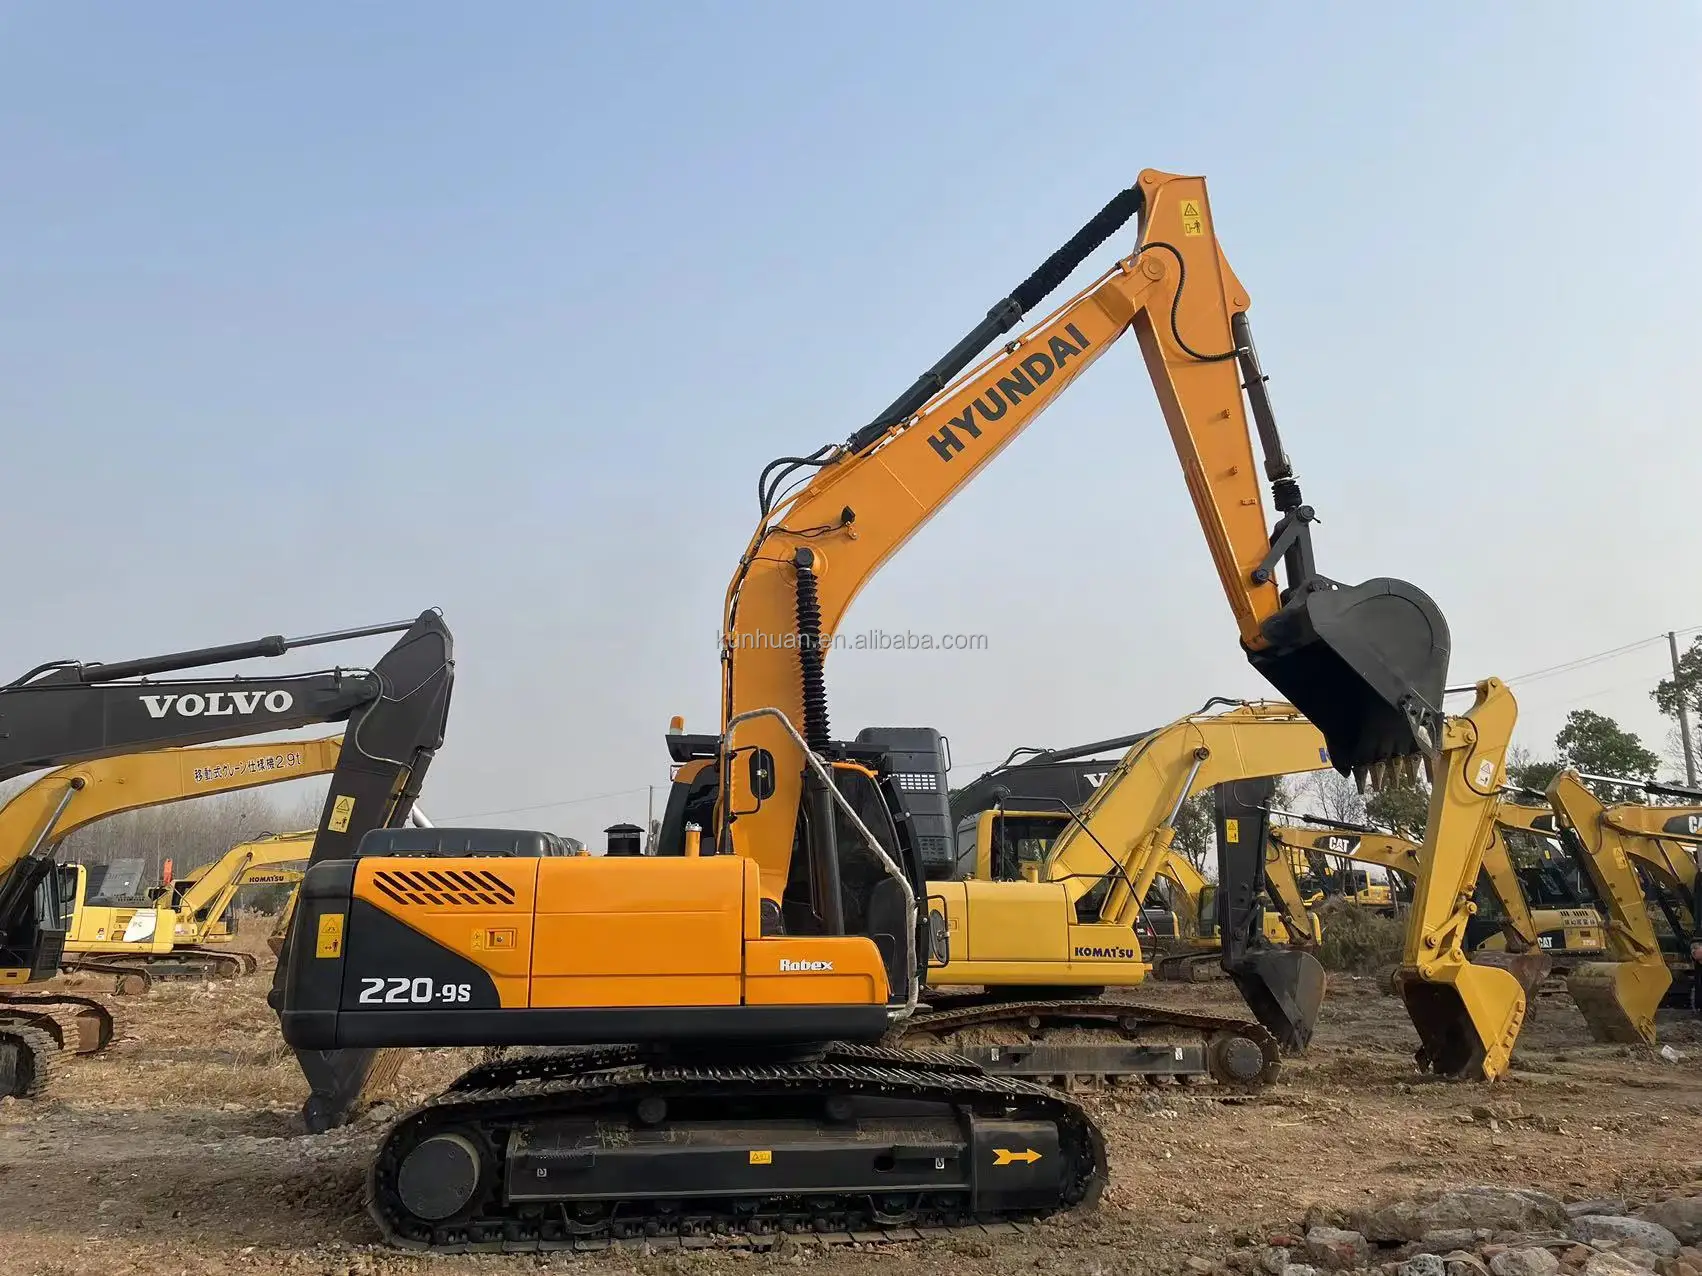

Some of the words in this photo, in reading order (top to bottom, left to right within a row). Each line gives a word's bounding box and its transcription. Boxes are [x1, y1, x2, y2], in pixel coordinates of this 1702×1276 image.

[926, 322, 1091, 463] HYUNDAI
[139, 690, 293, 718] VOLVO
[1329, 836, 1350, 852] CAT
[249, 874, 284, 883] KOMATSU
[1537, 936, 1553, 949] CAT
[1074, 946, 1134, 958] KOMATSU
[779, 958, 834, 971] Robex
